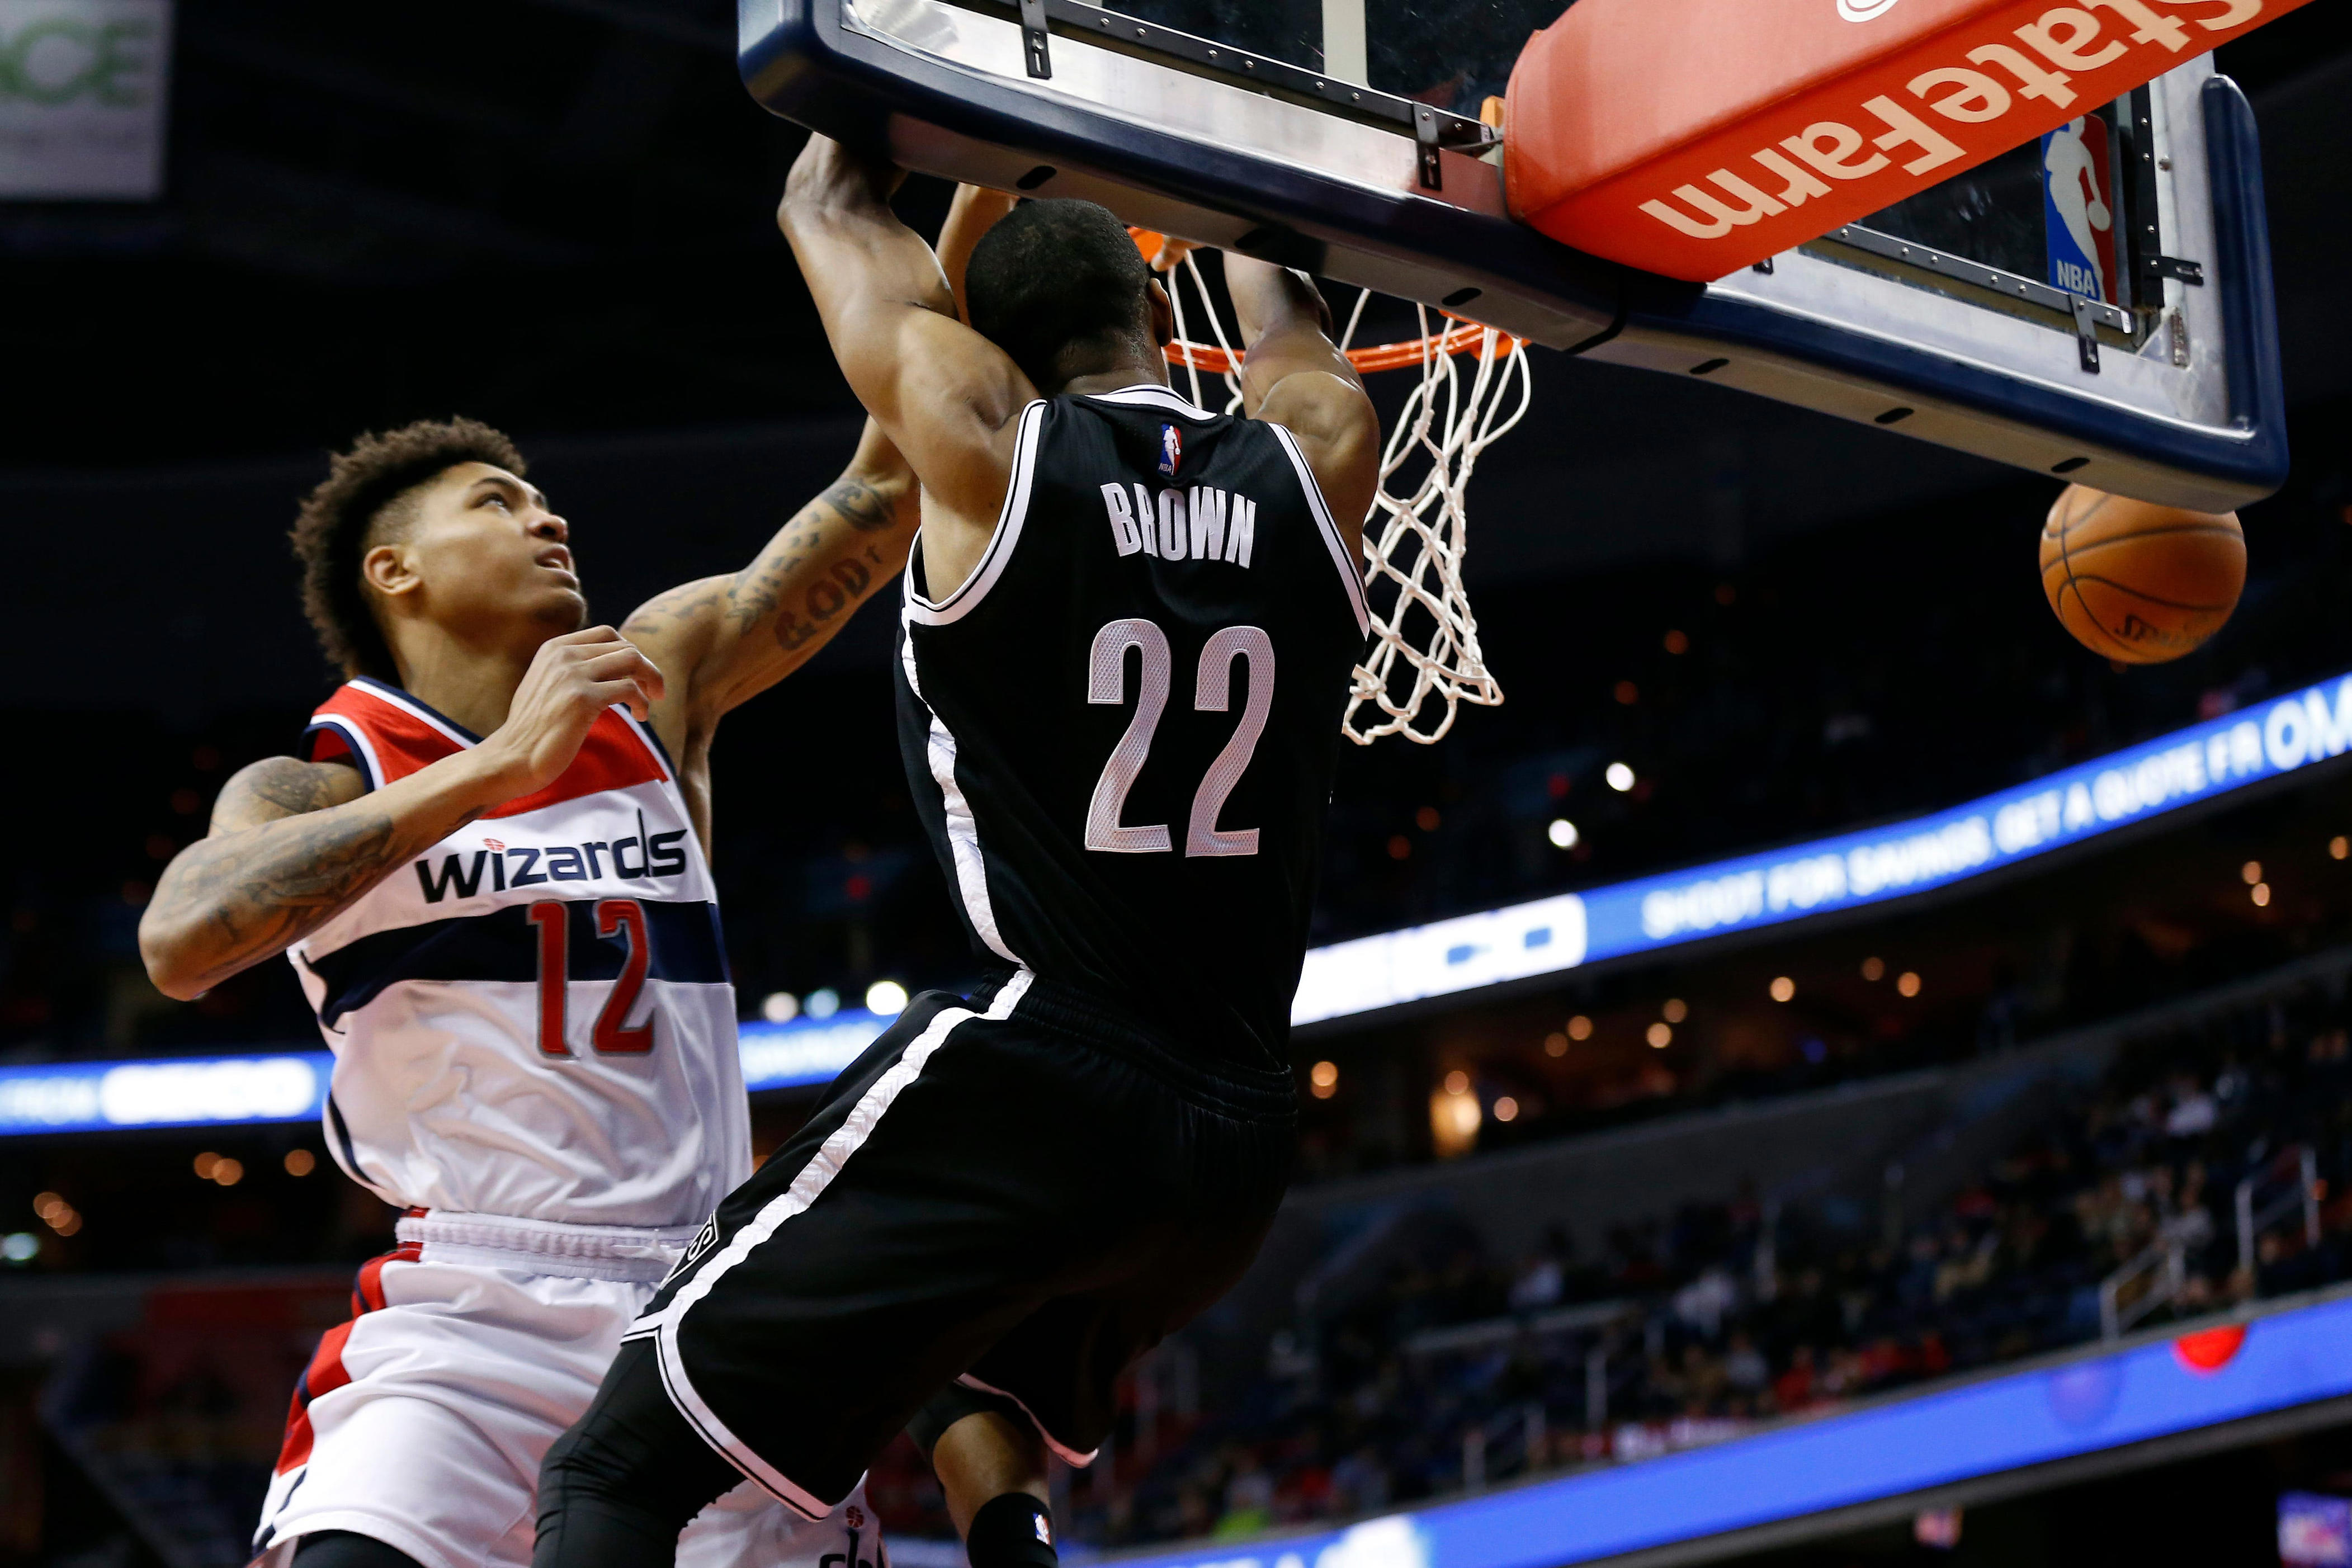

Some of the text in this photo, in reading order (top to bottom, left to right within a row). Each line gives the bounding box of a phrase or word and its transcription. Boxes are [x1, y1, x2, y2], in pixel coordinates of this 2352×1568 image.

[2056, 258, 2097, 299] NBA
[1099, 482, 1257, 569] BROWN
[1158, 462, 1172, 473] NBA
[1085, 618, 1275, 857] 22
[1768, 853, 1847, 910] FOR
[1995, 789, 2061, 853] GET
[2064, 781, 2095, 832] A
[2093, 740, 2206, 822] QUOTE
[526, 898, 654, 1059] 12
